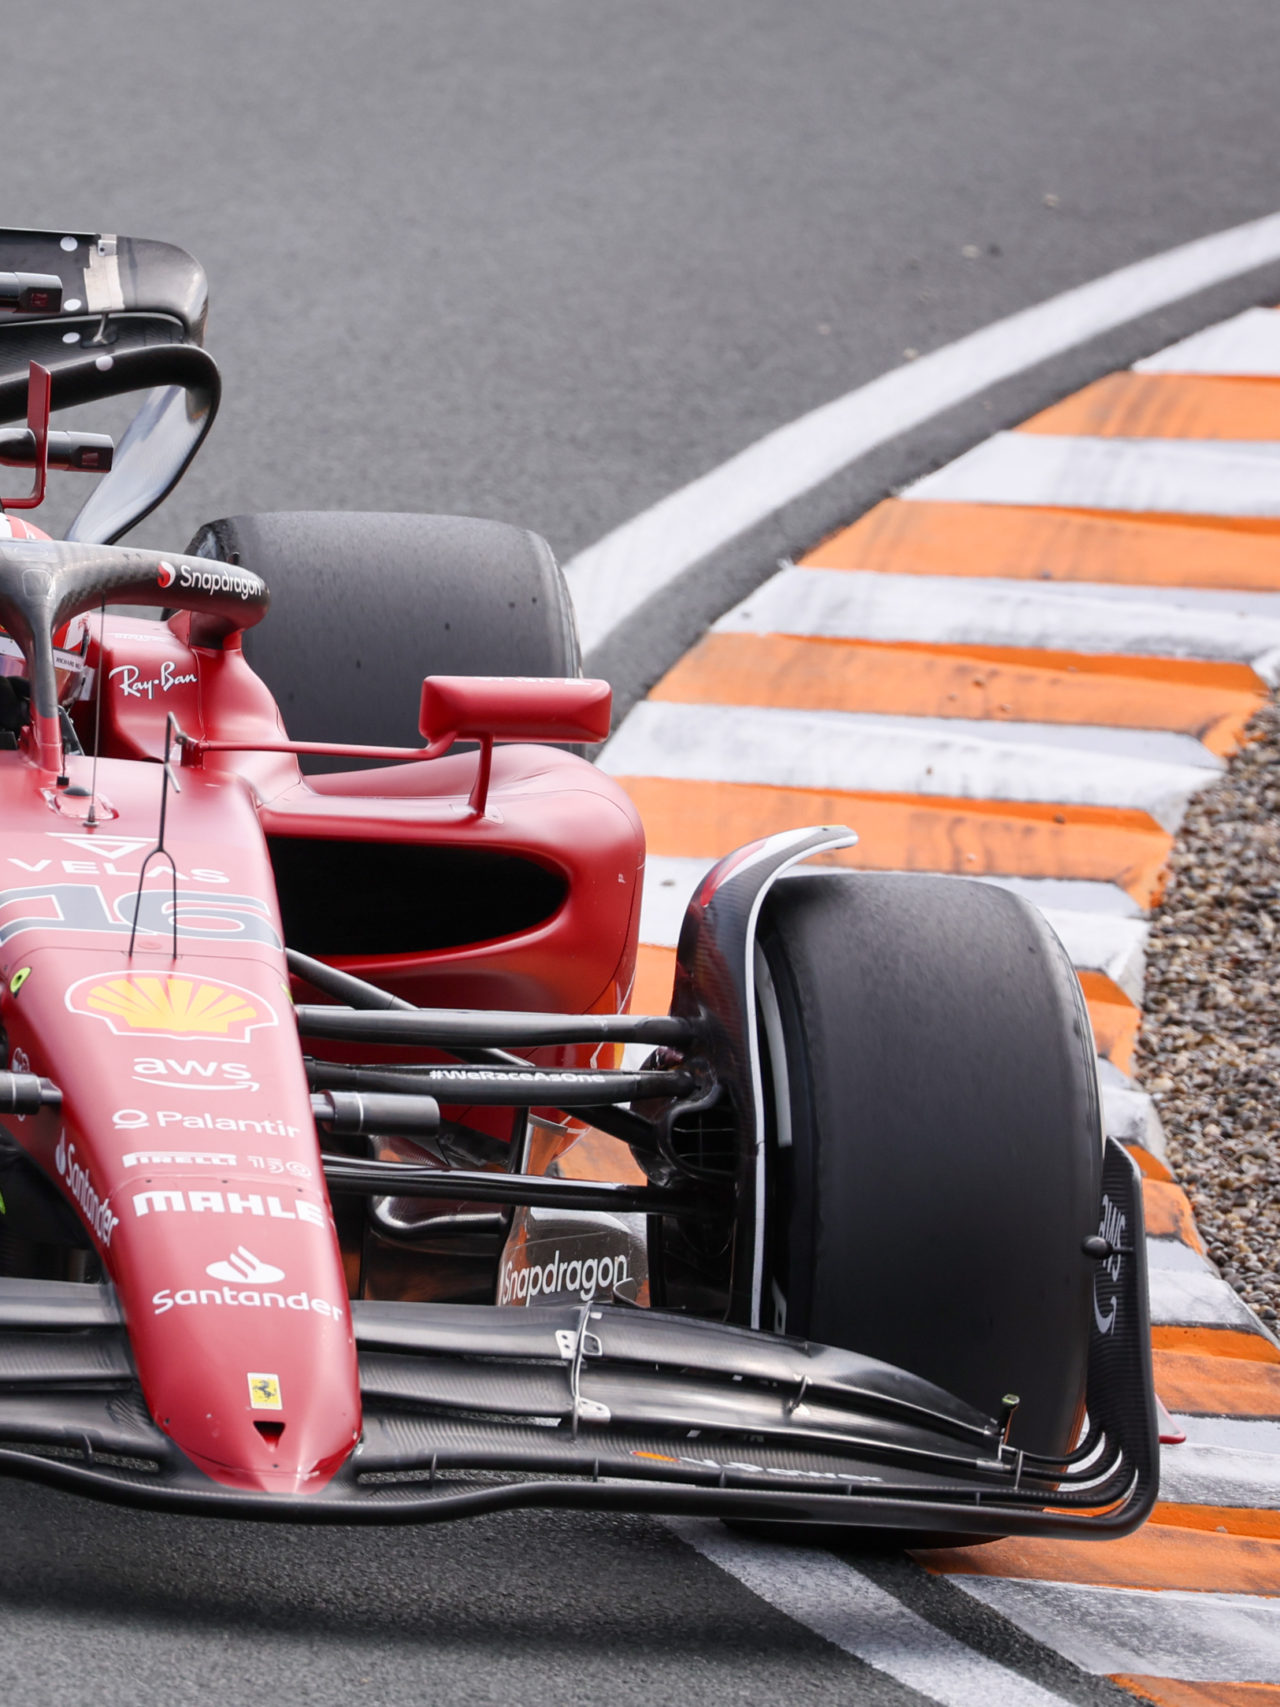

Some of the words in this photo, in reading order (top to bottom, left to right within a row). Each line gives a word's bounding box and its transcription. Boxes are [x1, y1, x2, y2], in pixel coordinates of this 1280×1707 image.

[180, 565, 261, 600] Snapdragon
[8, 857, 230, 884] VELAS
[134, 1057, 252, 1081] aws
[430, 1069, 605, 1084] #WeRaceAsOne
[156, 1111, 300, 1139] Palantir
[122, 1151, 237, 1168] PIRELLI
[66, 1143, 119, 1248] Santander
[132, 1191, 326, 1228] MAHLE
[503, 1250, 628, 1307] Snapdragon
[152, 1286, 343, 1322] Santander
